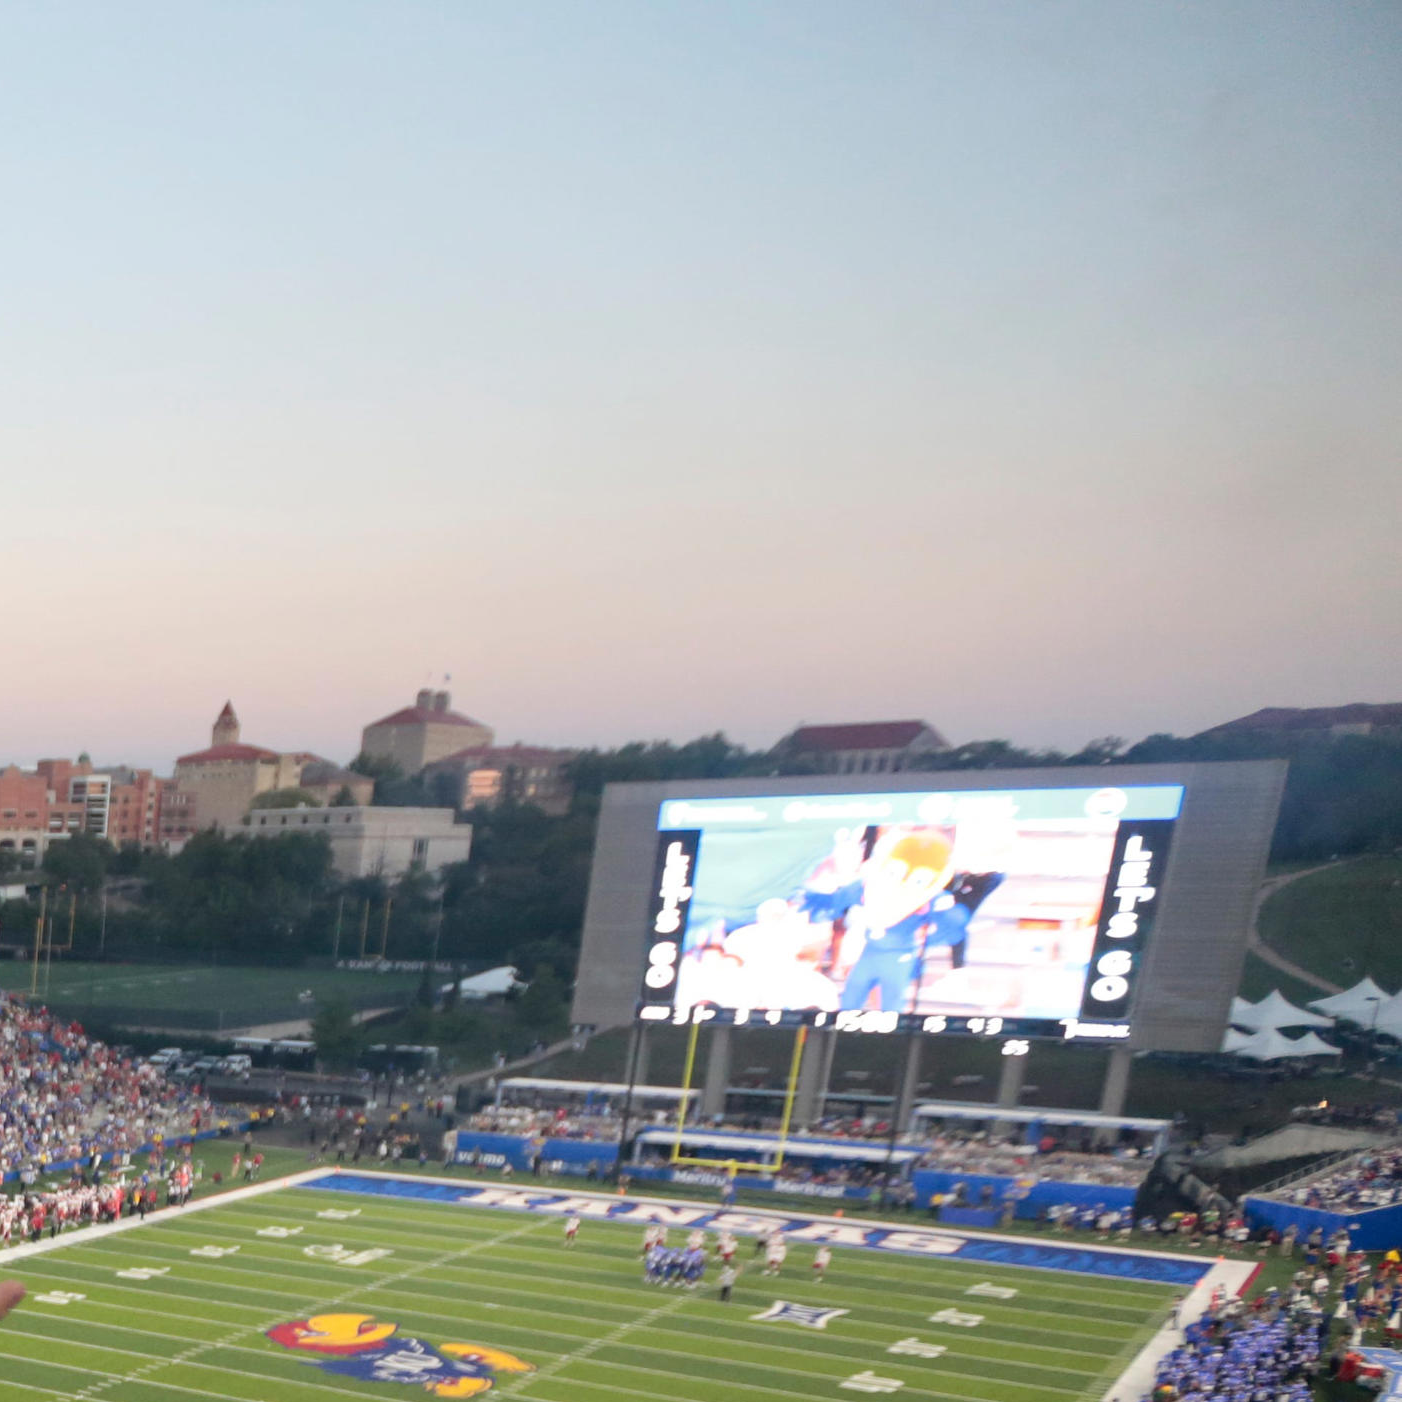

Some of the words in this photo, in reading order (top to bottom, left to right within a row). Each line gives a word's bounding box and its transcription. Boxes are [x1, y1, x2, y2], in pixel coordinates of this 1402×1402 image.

[1091, 949, 1132, 1002] GO
[458, 1152, 506, 1165] vemo
[458, 1187, 966, 1254] KANSAS
